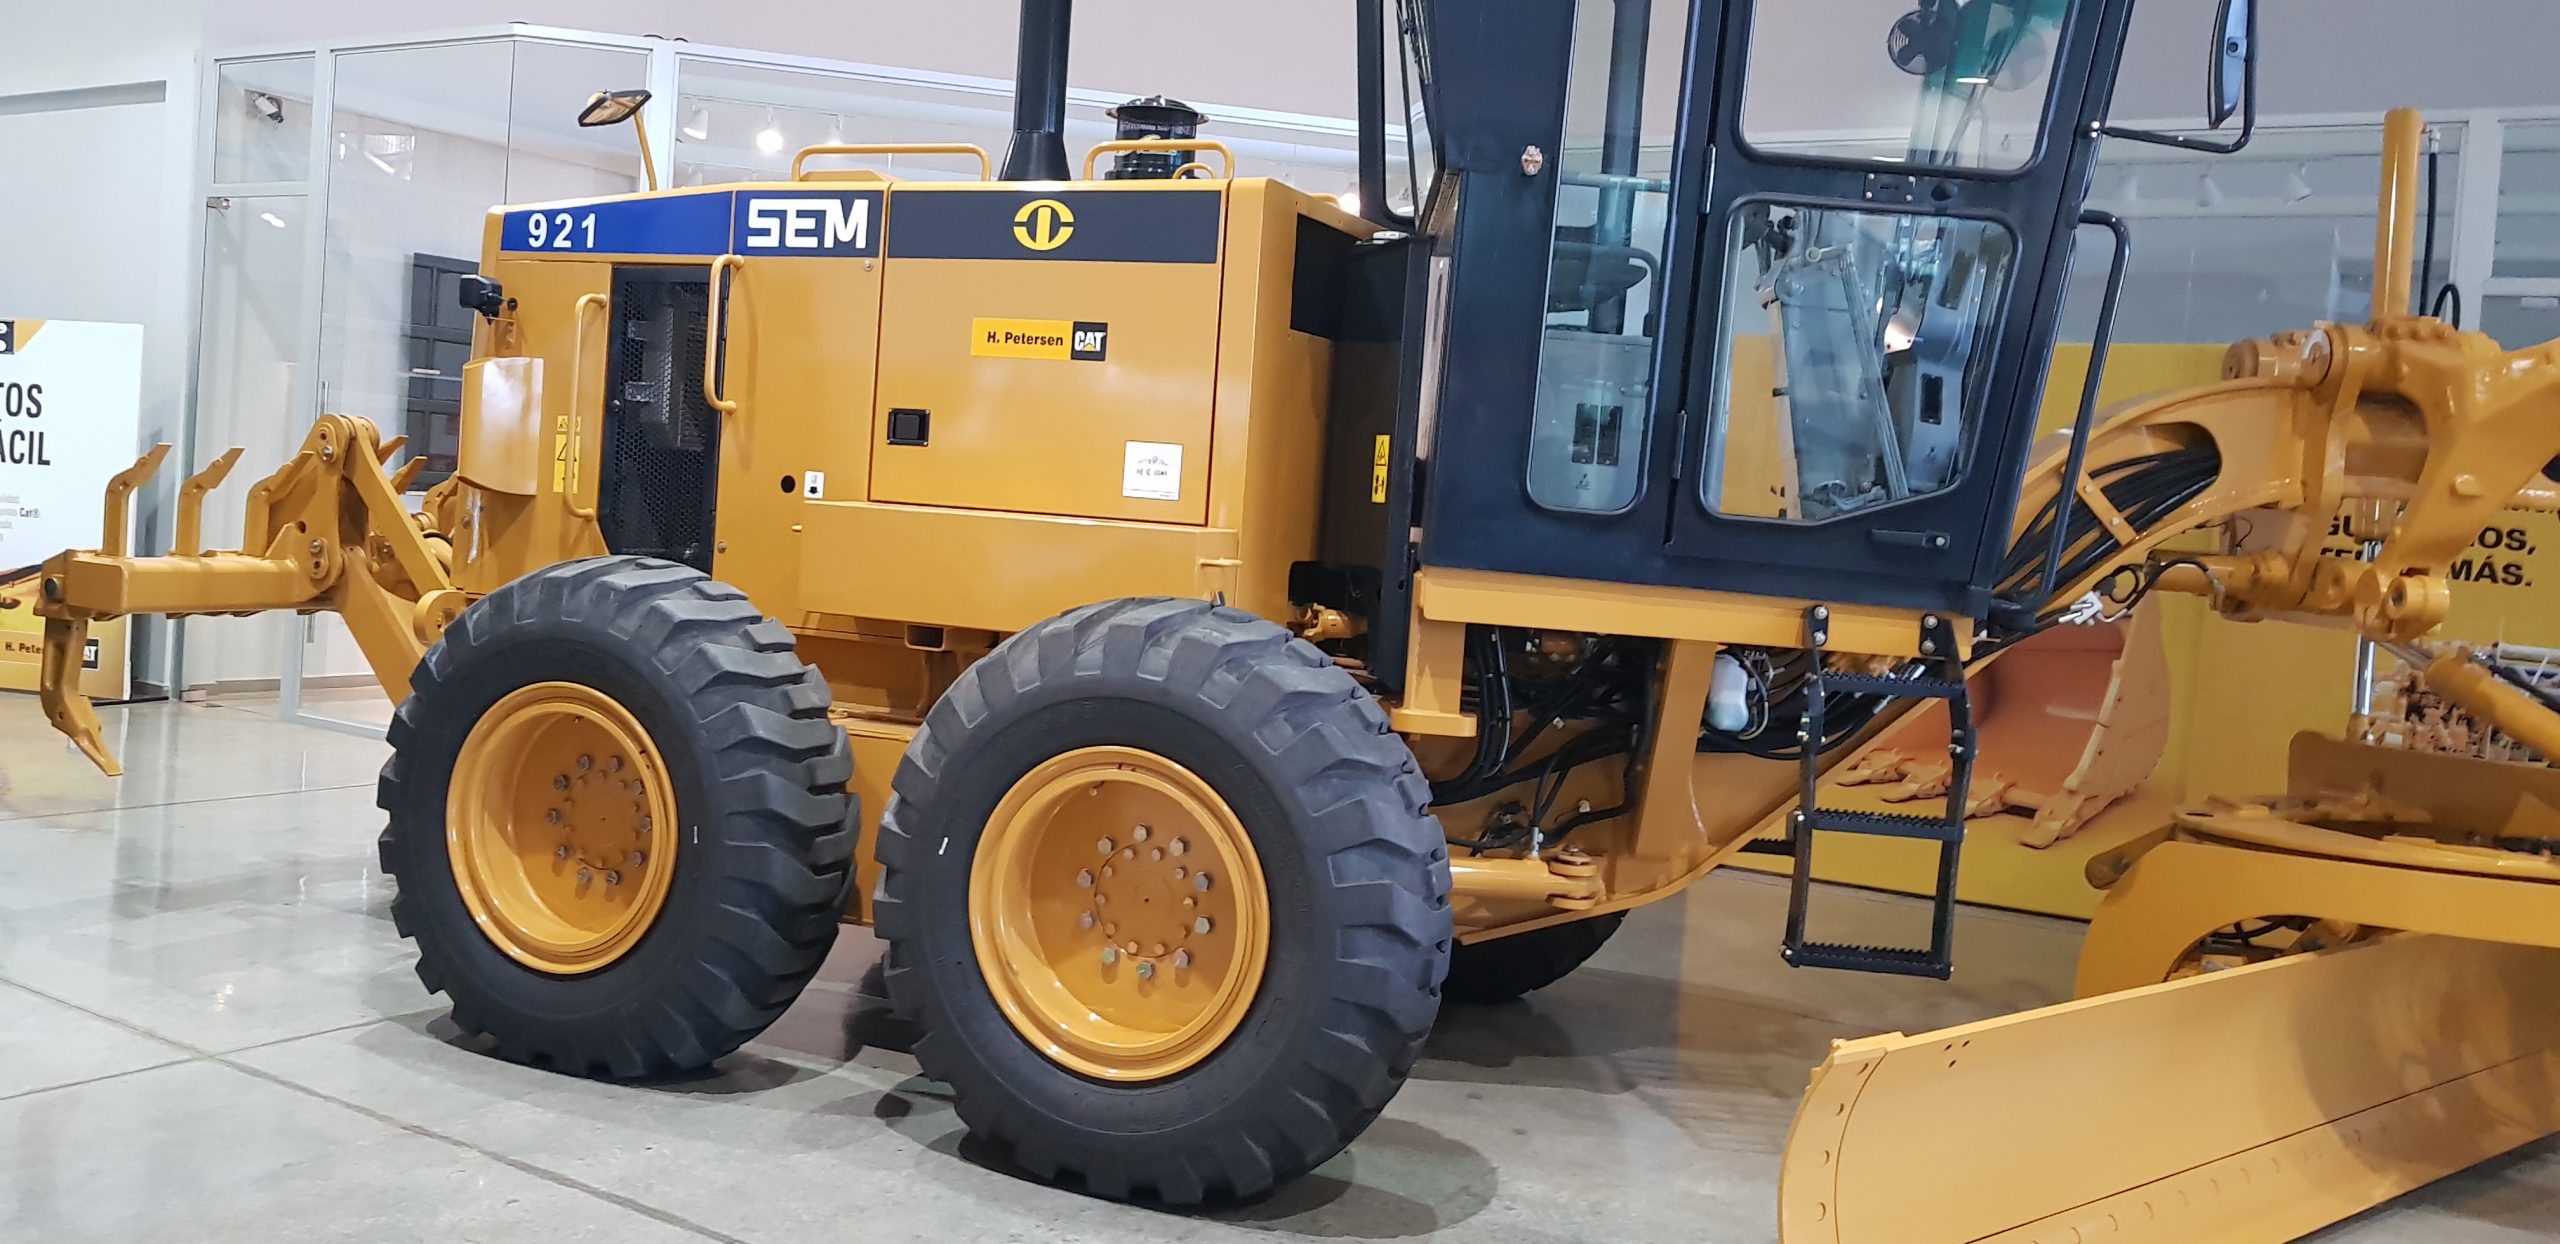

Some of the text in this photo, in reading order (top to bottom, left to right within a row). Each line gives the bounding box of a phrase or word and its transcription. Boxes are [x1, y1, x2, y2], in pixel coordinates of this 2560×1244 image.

[528, 212, 596, 248] 921
[747, 198, 869, 249] SEM
[986, 330, 1107, 352] H. Petersen CAT
[0, 382, 43, 418] OS
[18, 642, 44, 655] Pete
